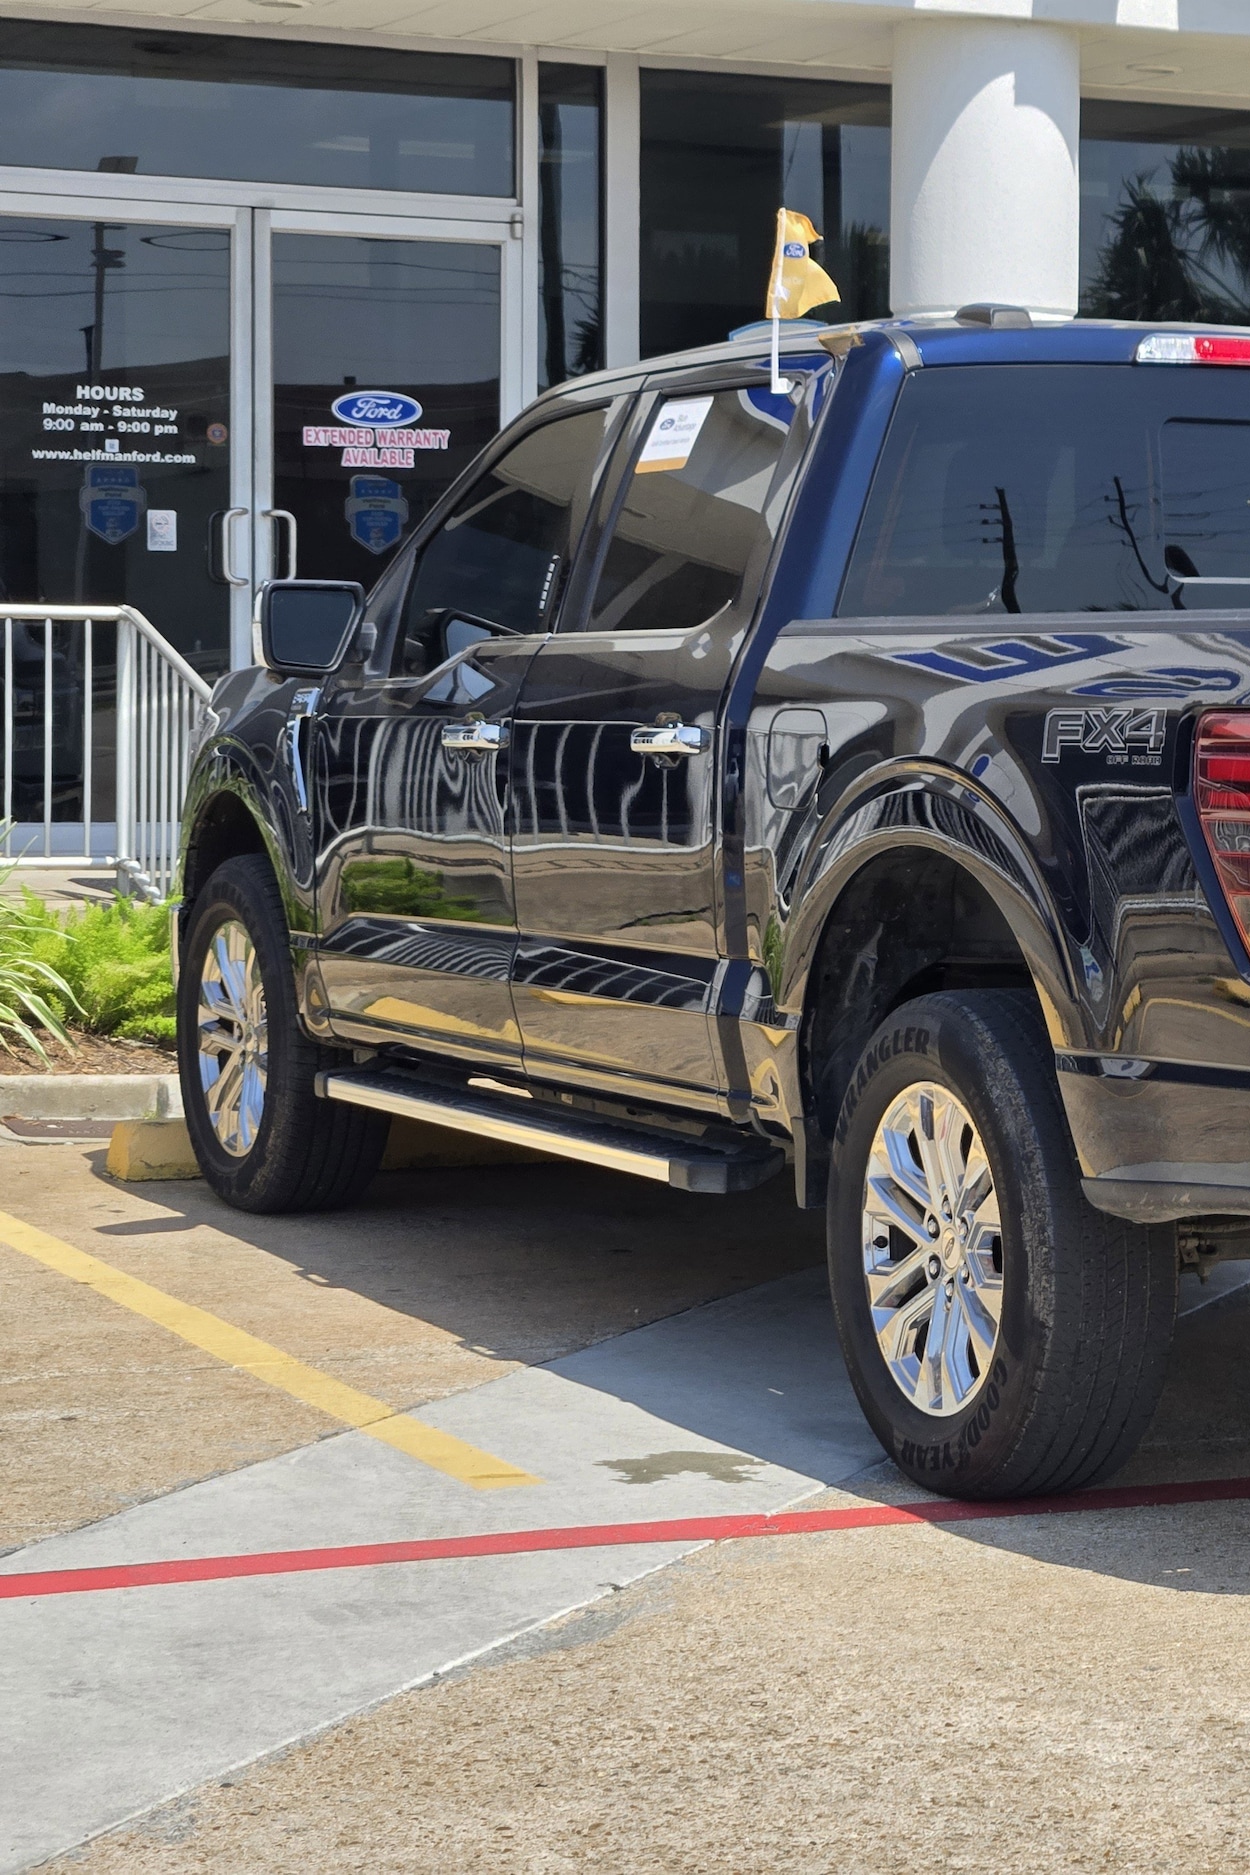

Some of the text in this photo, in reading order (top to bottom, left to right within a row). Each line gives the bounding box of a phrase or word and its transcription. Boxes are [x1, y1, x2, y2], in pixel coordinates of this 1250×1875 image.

[76, 385, 145, 401] HOURS
[43, 402, 100, 418] Monday
[112, 405, 178, 421] Saturday
[351, 397, 403, 420] Ford
[43, 418, 75, 431] 9:00
[80, 421, 105, 432] am
[117, 421, 151, 433] 9:00
[154, 425, 178, 436] pm
[304, 427, 450, 448] EXTENDED WARRANTY
[32, 449, 196, 464] www.helfmanford.com
[343, 449, 414, 467] AVAILABLE
[1041, 707, 1168, 764] FX4
[1106, 754, 1162, 766] OFF ROAD
[836, 1026, 930, 1146] WRANGLER
[901, 1357, 1008, 1471] GOODYEAR
